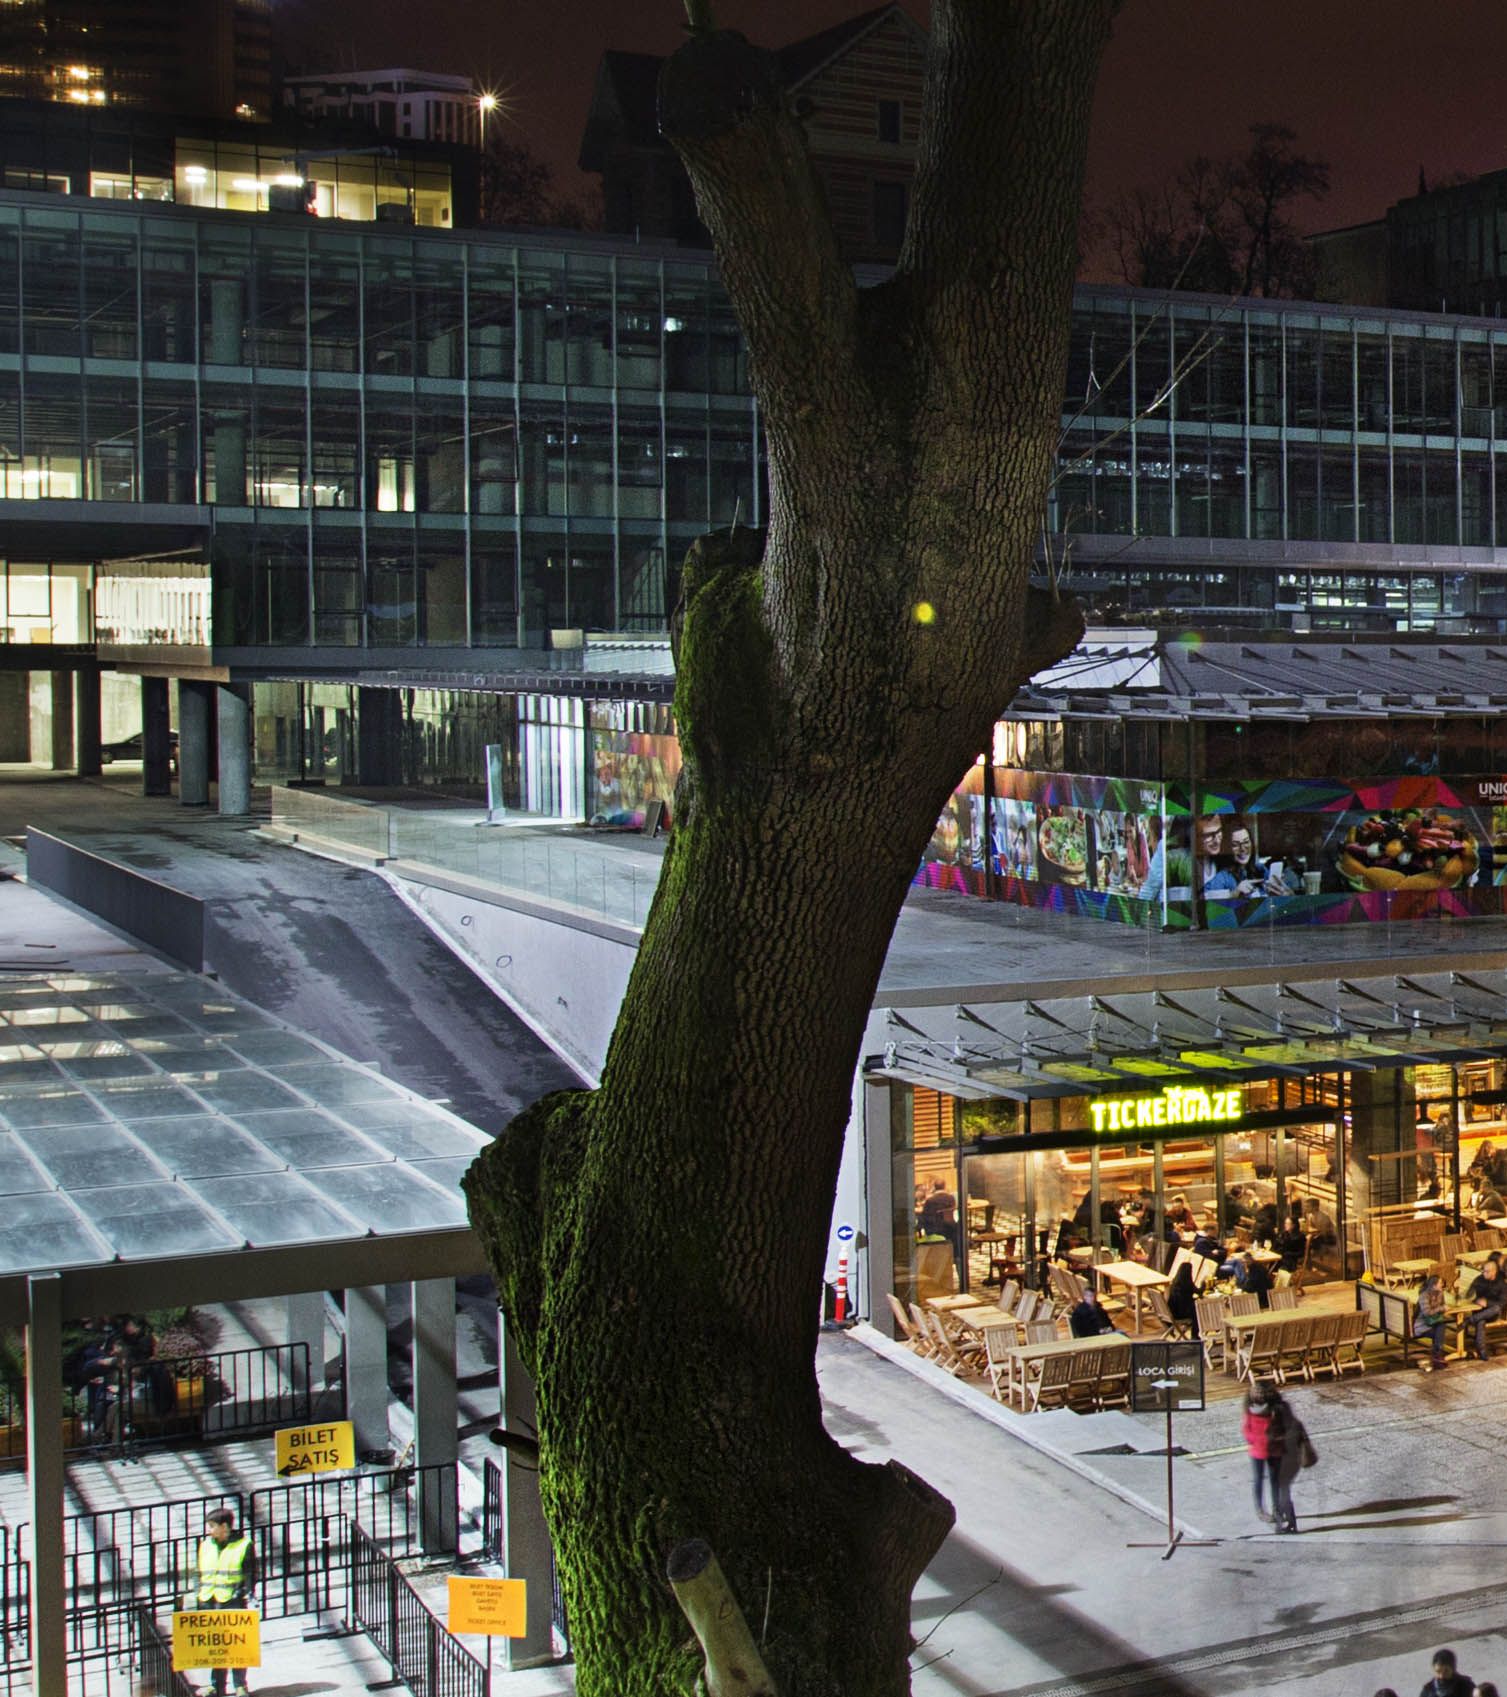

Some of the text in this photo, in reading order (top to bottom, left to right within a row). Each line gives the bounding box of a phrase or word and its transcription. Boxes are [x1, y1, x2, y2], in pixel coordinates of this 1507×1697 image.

[1138, 1366, 1166, 1377] LOCA
[290, 1428, 337, 1448] BİLET
[288, 1449, 340, 1468] SATIŞ
[179, 1613, 253, 1629] PREMIUM
[188, 1629, 246, 1647] TRİBÜN
